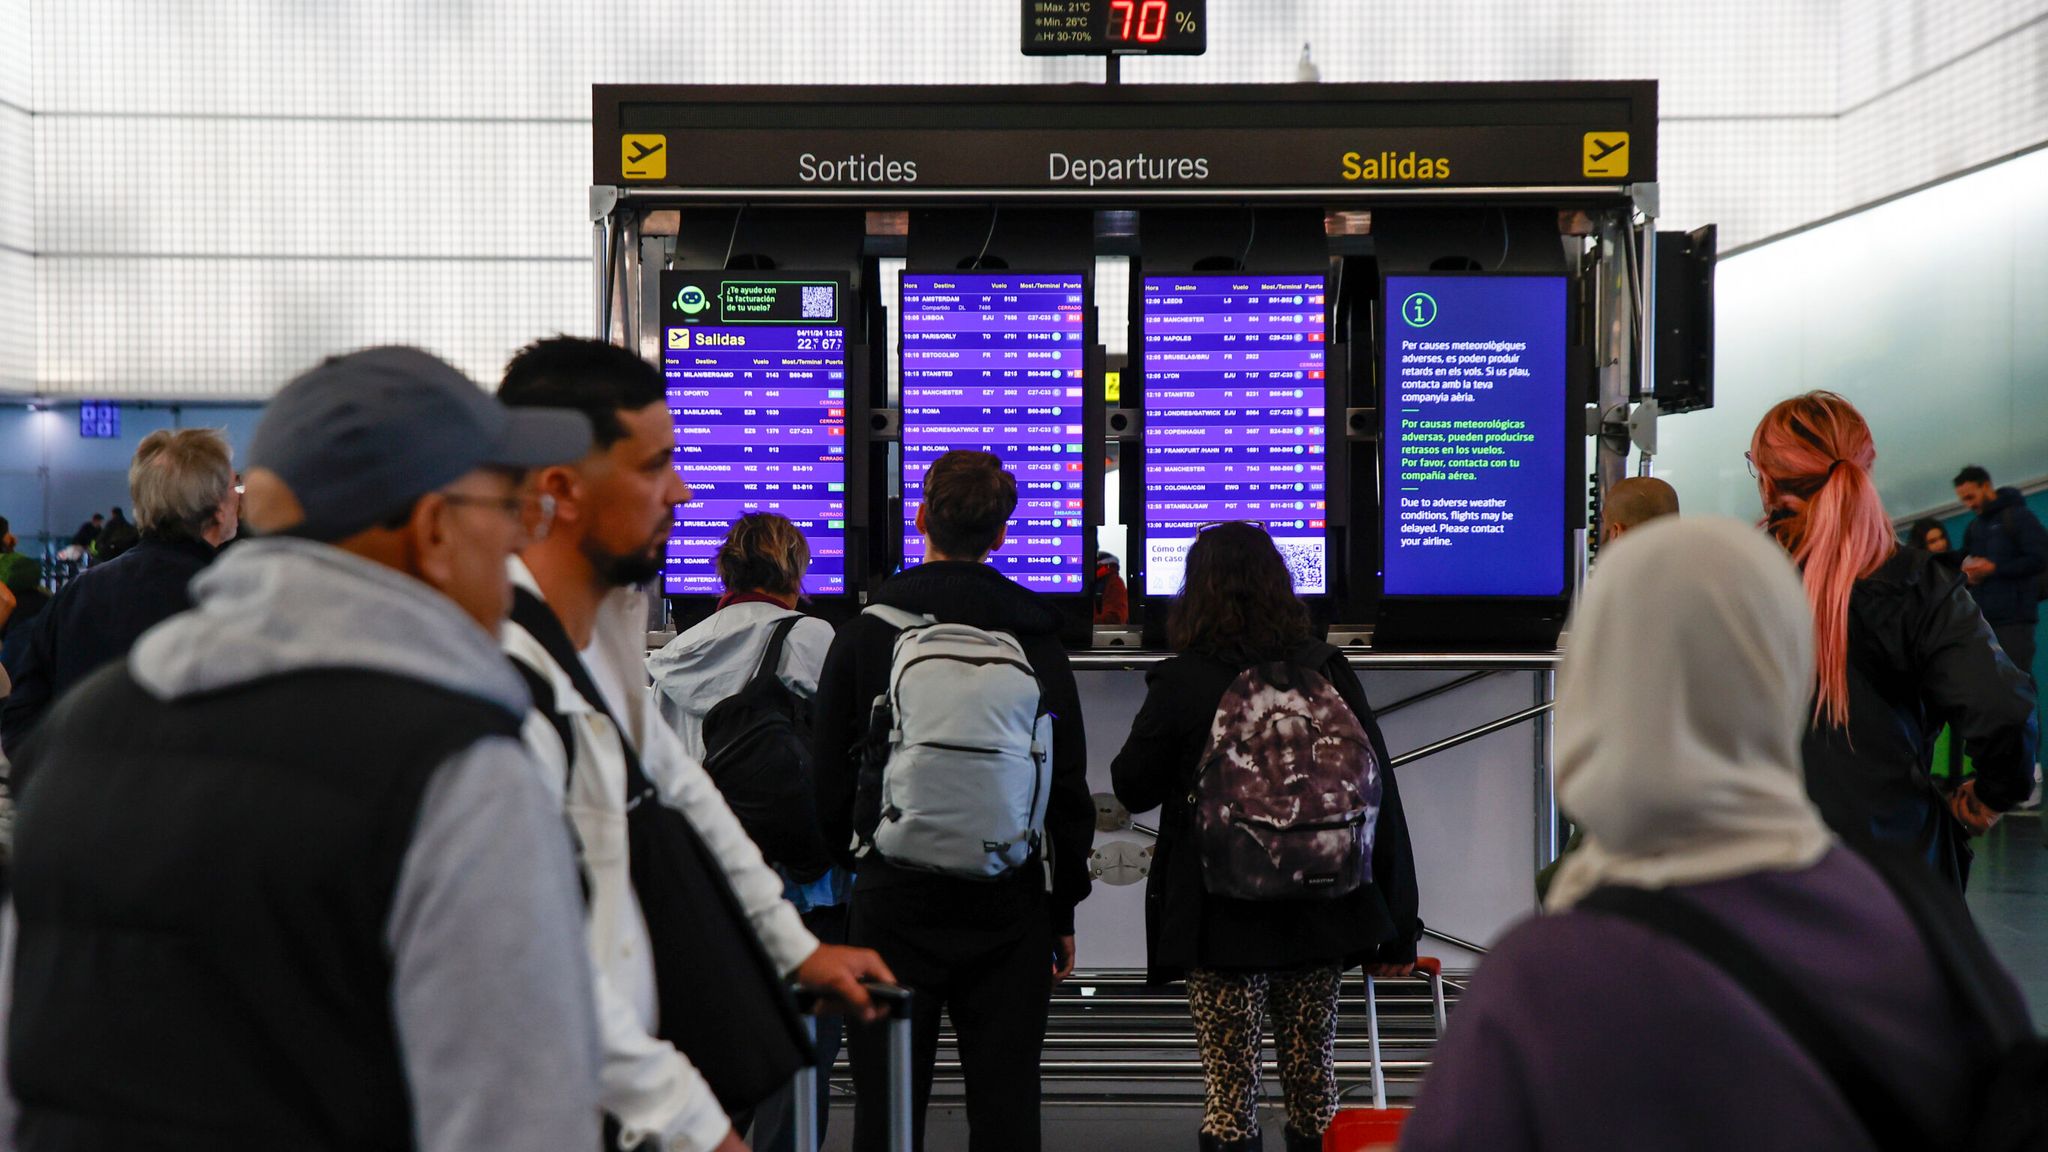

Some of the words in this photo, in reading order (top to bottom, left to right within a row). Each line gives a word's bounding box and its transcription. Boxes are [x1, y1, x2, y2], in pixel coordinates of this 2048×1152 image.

[1043, 3, 1065, 11] Max.
[1043, 18, 1062, 26] Min.
[1108, 0, 1167, 41] 70
[1176, 12, 1195, 32] %
[1043, 32, 1053, 40] Hr
[1057, 32, 1091, 41] 30-70%
[800, 154, 917, 181] Sortides
[1050, 153, 1208, 186] Departures
[1343, 152, 1449, 179] Salidas
[727, 287, 739, 295] ¿Te
[741, 287, 762, 295] ayudo
[735, 294, 775, 302] facturación
[696, 333, 745, 345] Salidas
[1402, 341, 1417, 350] Per
[1419, 342, 1450, 350] causes
[1452, 341, 1526, 352] meteorològiques
[1402, 354, 1444, 363] adverses,
[1459, 354, 1486, 364] poden
[1488, 354, 1520, 364] produir
[1402, 367, 1433, 376] retards
[1448, 367, 1461, 376] els
[1464, 367, 1484, 376] vols.
[1486, 367, 1494, 376] Si
[1509, 367, 1530, 377] plau,
[1402, 380, 1440, 388] contacta
[1442, 380, 1461, 389] amb
[1463, 380, 1471, 388] la
[1473, 381, 1493, 389] teva
[1402, 392, 1449, 403] companyia
[1451, 392, 1475, 401] aèria.
[1402, 419, 1418, 428] Por
[1454, 420, 1525, 430] meteorológicas
[1402, 432, 1445, 442] adversas,
[1448, 433, 1483, 442] pueden
[1485, 433, 1534, 443] producirse
[1402, 446, 1439, 454] retrasos
[1456, 445, 1469, 454] los
[1472, 446, 1505, 454] vuelos.
[1402, 458, 1417, 466] Por
[1420, 458, 1446, 467] favor,
[1448, 459, 1488, 467] contacta
[1402, 471, 1445, 481] compañía
[1448, 471, 1476, 480] aérea.
[1401, 498, 1419, 507] Due
[1421, 499, 1430, 507] to
[1433, 498, 1468, 507] adverse
[1470, 498, 1506, 507] weather
[1401, 511, 1448, 520] conditions,
[1451, 511, 1479, 522] flights
[1481, 513, 1500, 522] may
[1502, 511, 1513, 520] be
[1401, 524, 1437, 534] delayed.
[1440, 524, 1469, 533] Please
[1471, 525, 1504, 533] contact
[1401, 538, 1421, 547] your
[1423, 537, 1452, 545] airline.
